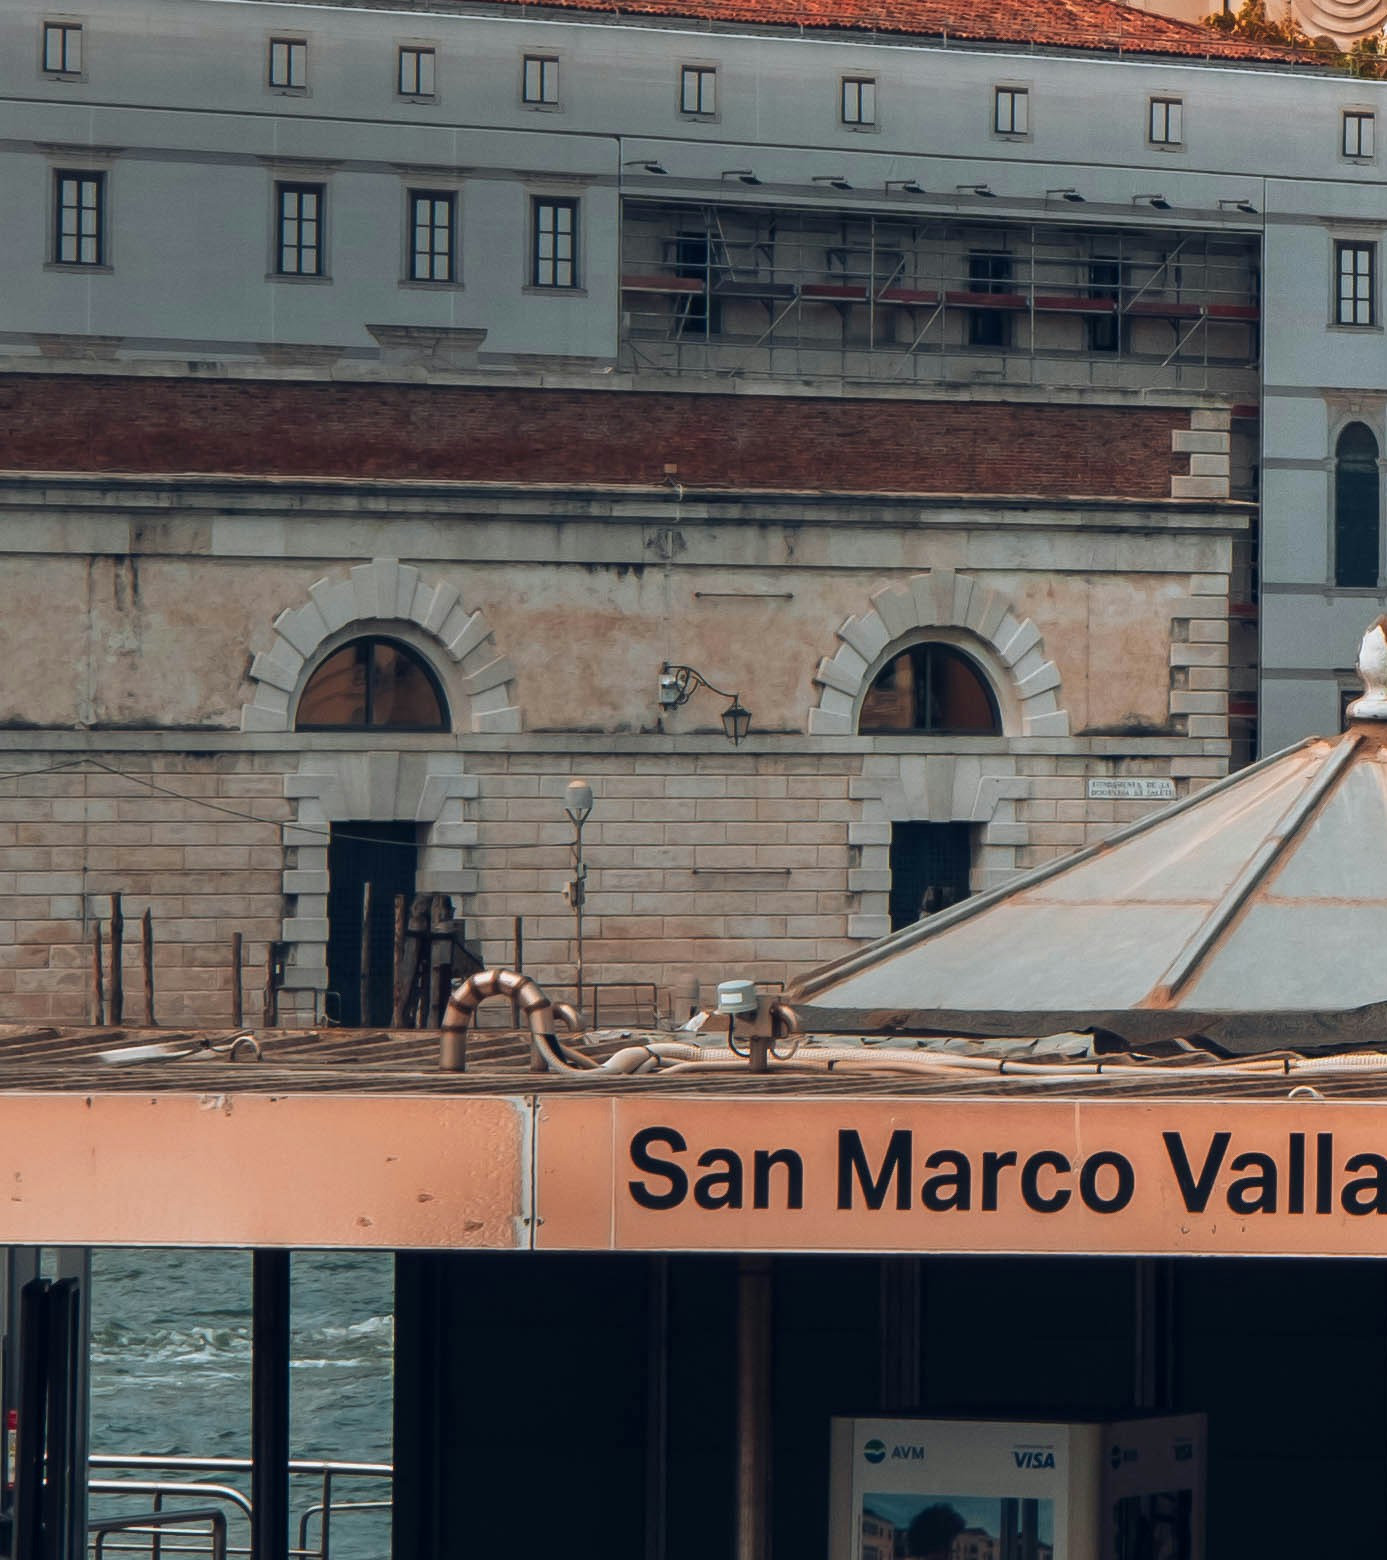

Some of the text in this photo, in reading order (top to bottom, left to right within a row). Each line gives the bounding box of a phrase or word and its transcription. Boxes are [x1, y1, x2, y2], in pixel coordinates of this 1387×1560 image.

[628, 1127, 804, 1212] San
[837, 1129, 1135, 1215] Marco
[891, 1445, 925, 1460] AVM
[1013, 1451, 1056, 1469] VISA
